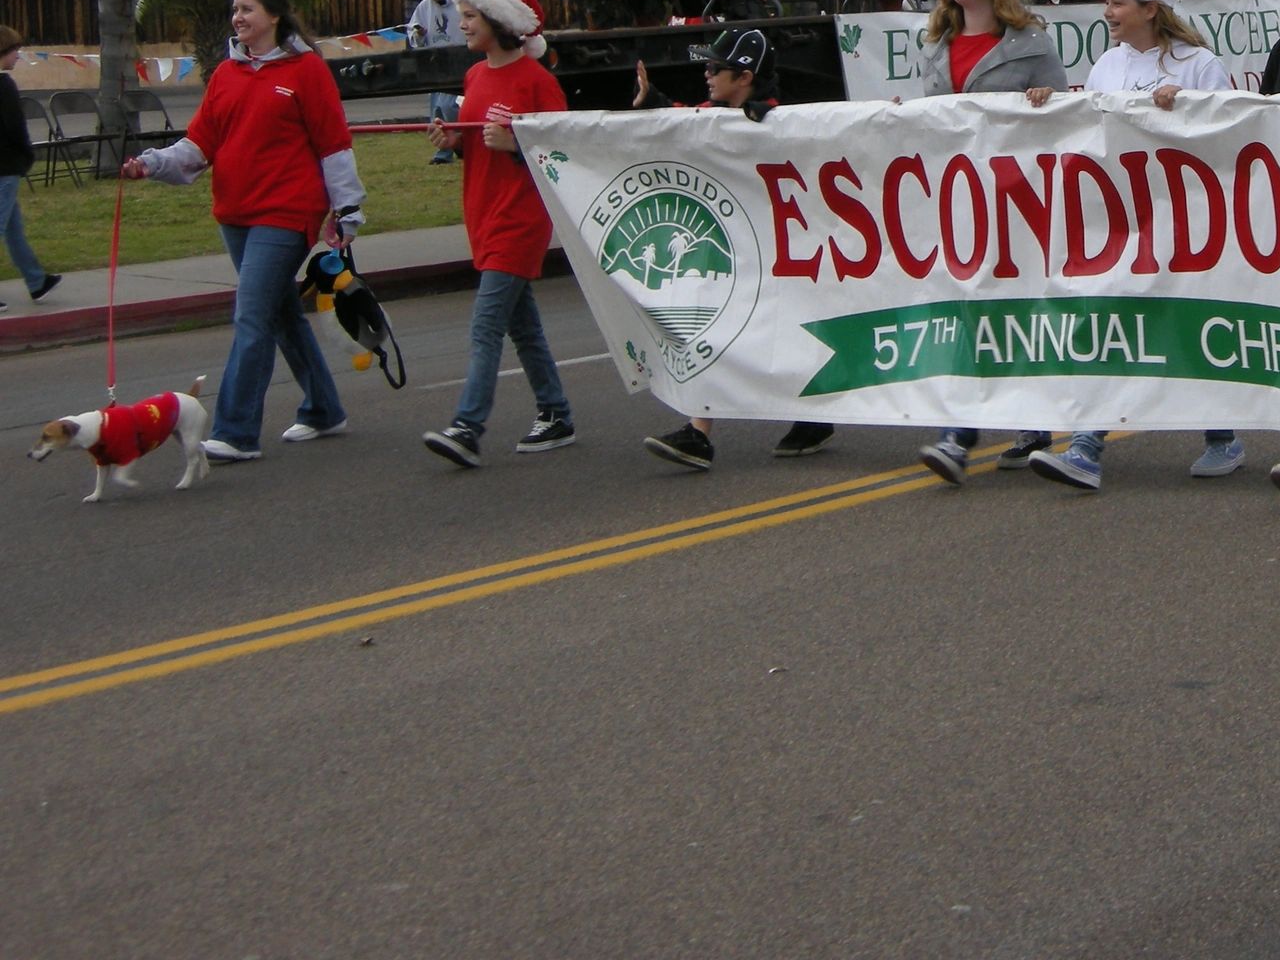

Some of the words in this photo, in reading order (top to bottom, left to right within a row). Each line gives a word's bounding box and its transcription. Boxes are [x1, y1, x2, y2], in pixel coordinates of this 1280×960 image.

[592, 168, 734, 227] ESCONDIDO
[873, 316, 957, 371] 57TH
[975, 313, 1167, 364] ANNUAL
